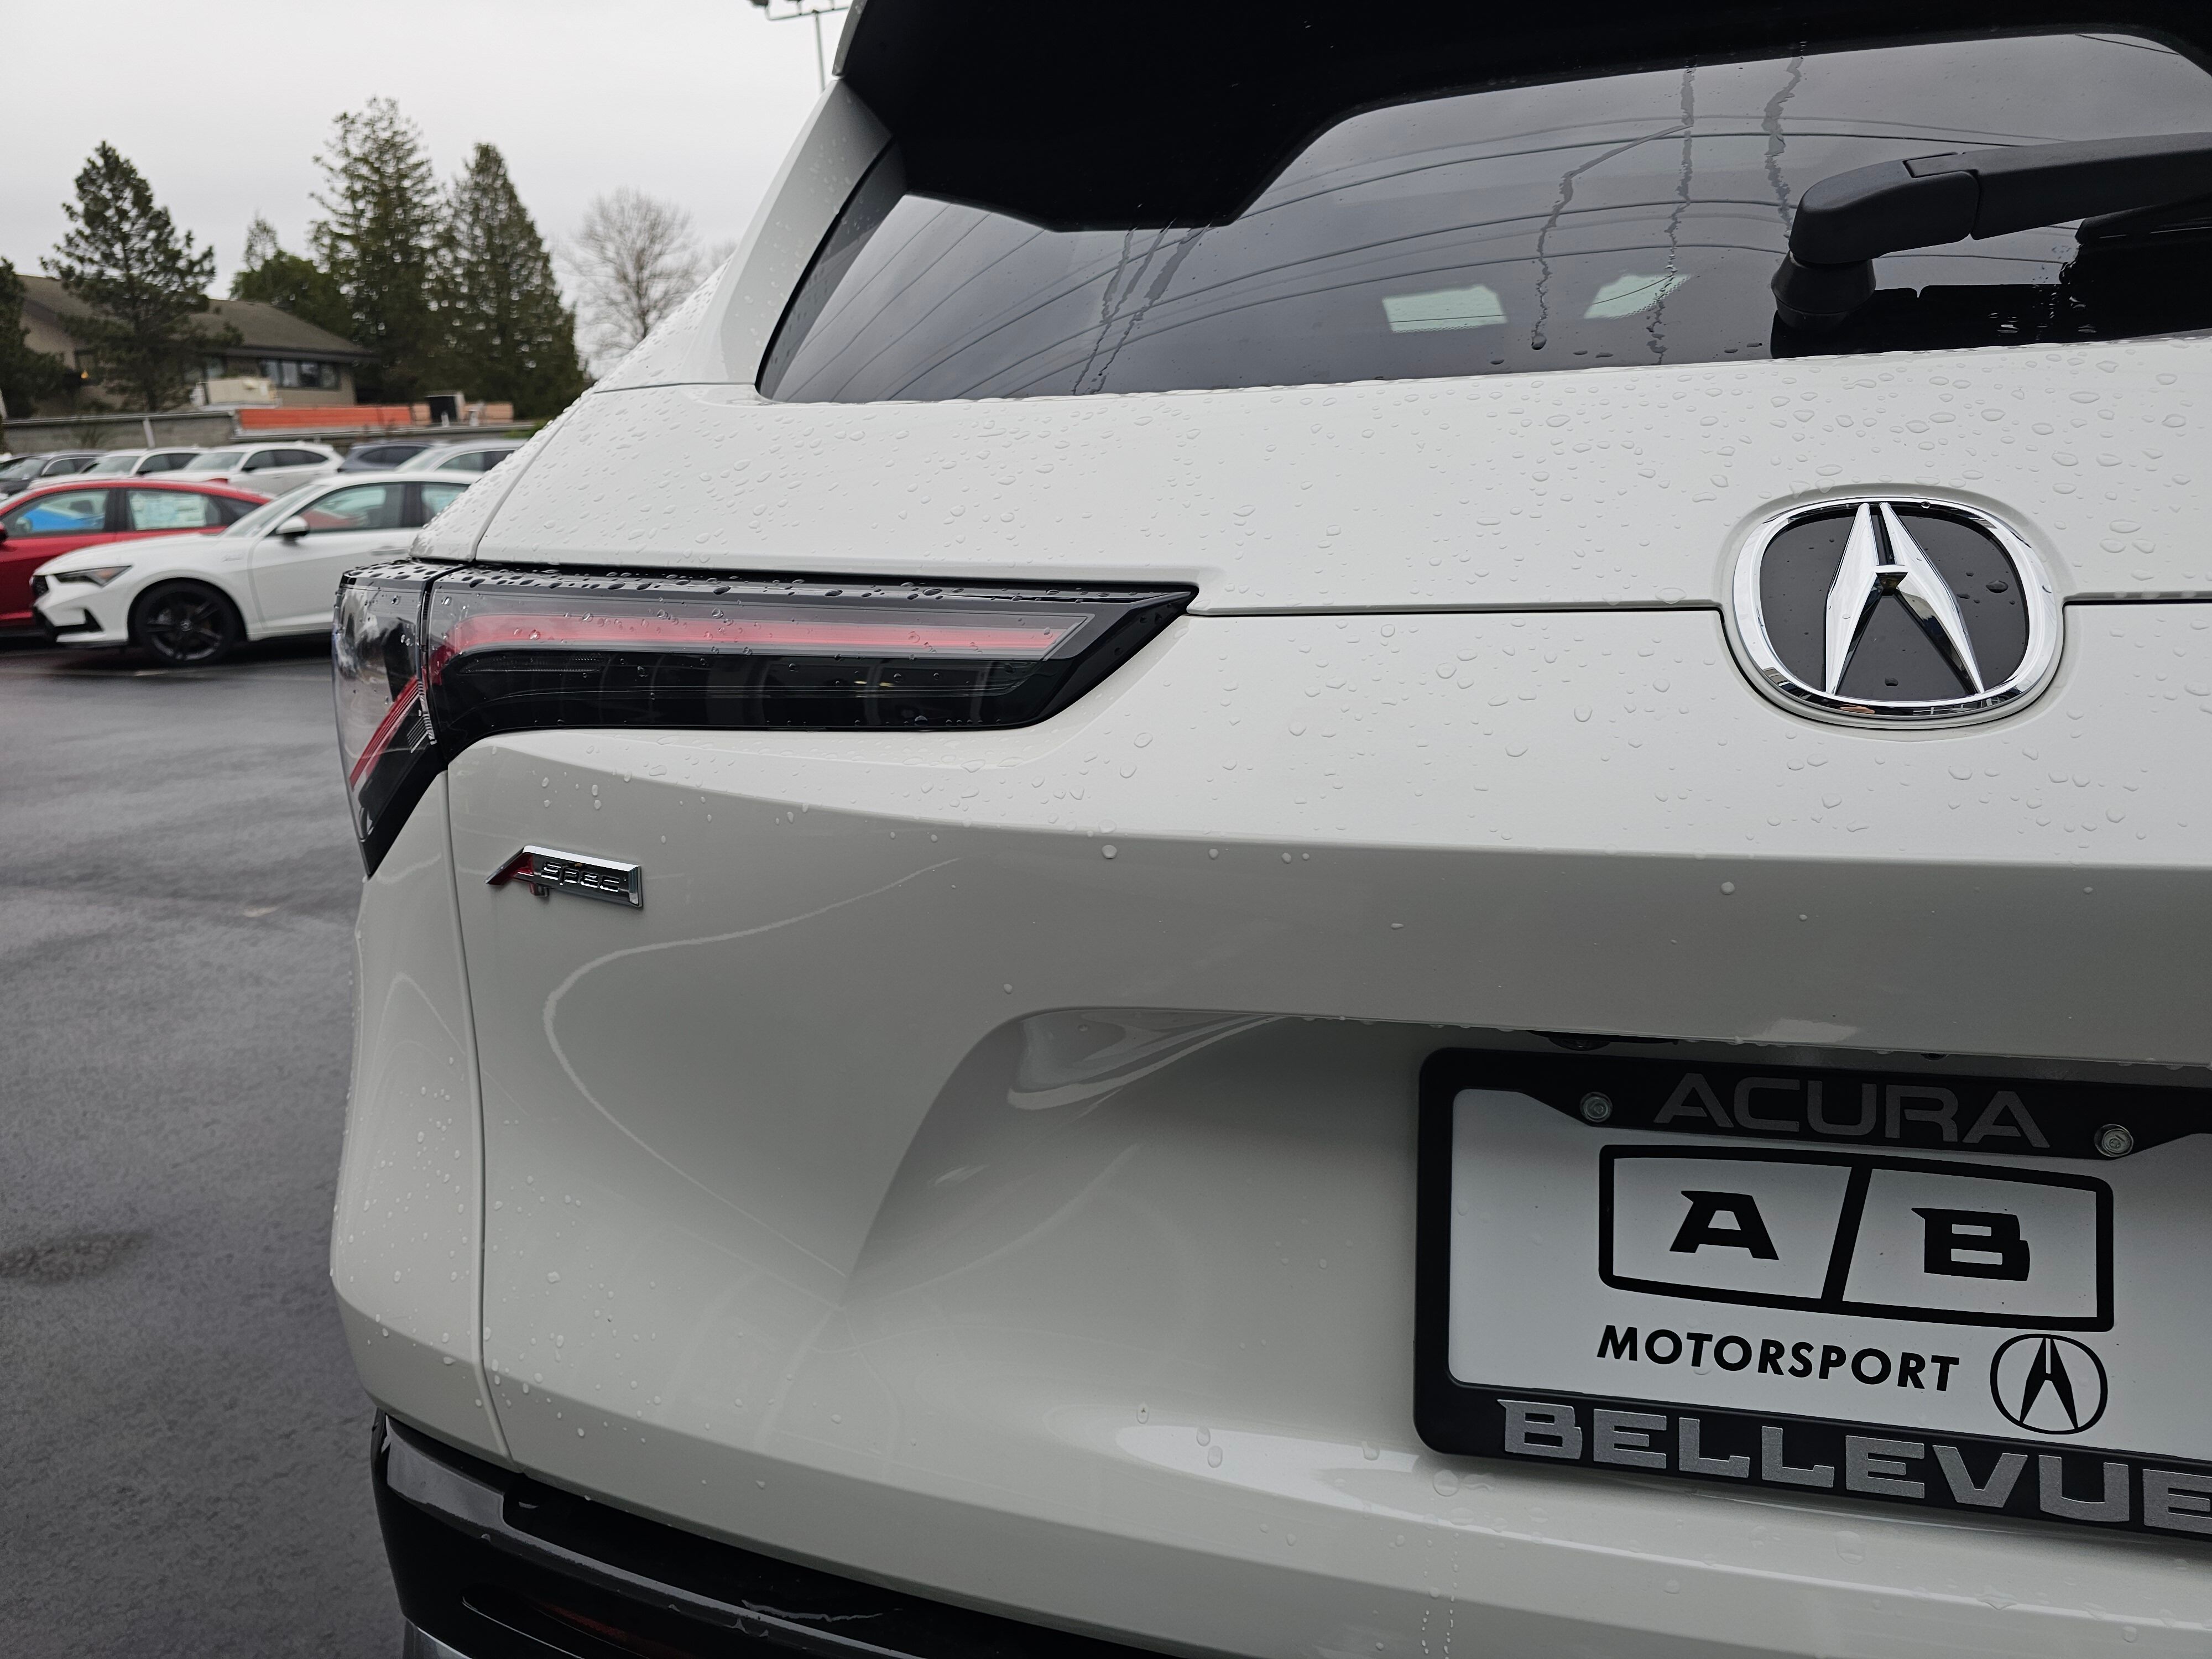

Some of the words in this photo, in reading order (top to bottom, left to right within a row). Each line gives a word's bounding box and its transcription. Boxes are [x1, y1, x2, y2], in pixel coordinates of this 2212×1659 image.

[1653, 1072, 2051, 1148] ACURA
[1670, 1190, 1779, 1260] A
[1911, 1207, 2030, 1281] B
[1597, 1324, 1960, 1391] MOTORSPORT
[1496, 1399, 2212, 1534] BELLEVUE
